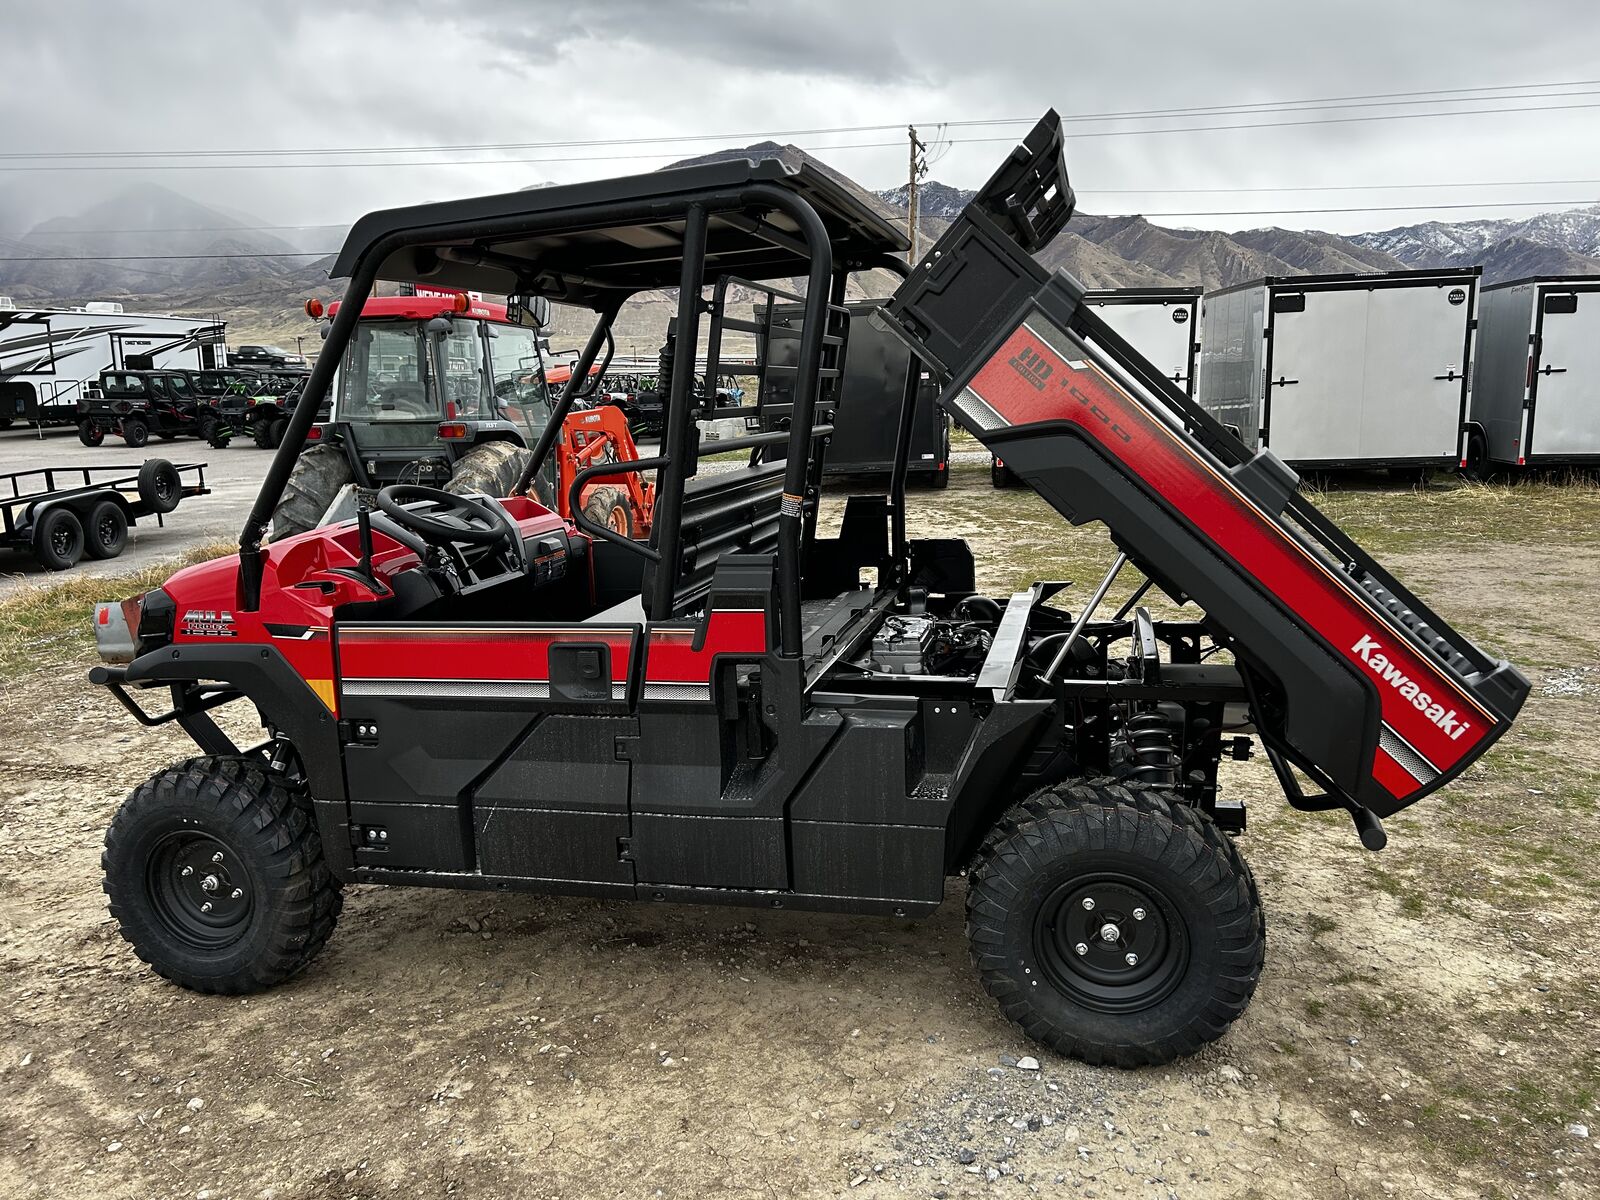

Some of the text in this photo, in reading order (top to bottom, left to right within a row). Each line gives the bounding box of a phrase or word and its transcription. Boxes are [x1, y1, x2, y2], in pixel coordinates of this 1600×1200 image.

[472, 308, 490, 316] KUBOTA
[1018, 346, 1053, 380] HD
[1060, 378, 1131, 443] 1000
[181, 609, 236, 624] MULE
[1351, 634, 1471, 741] Kawasaki
